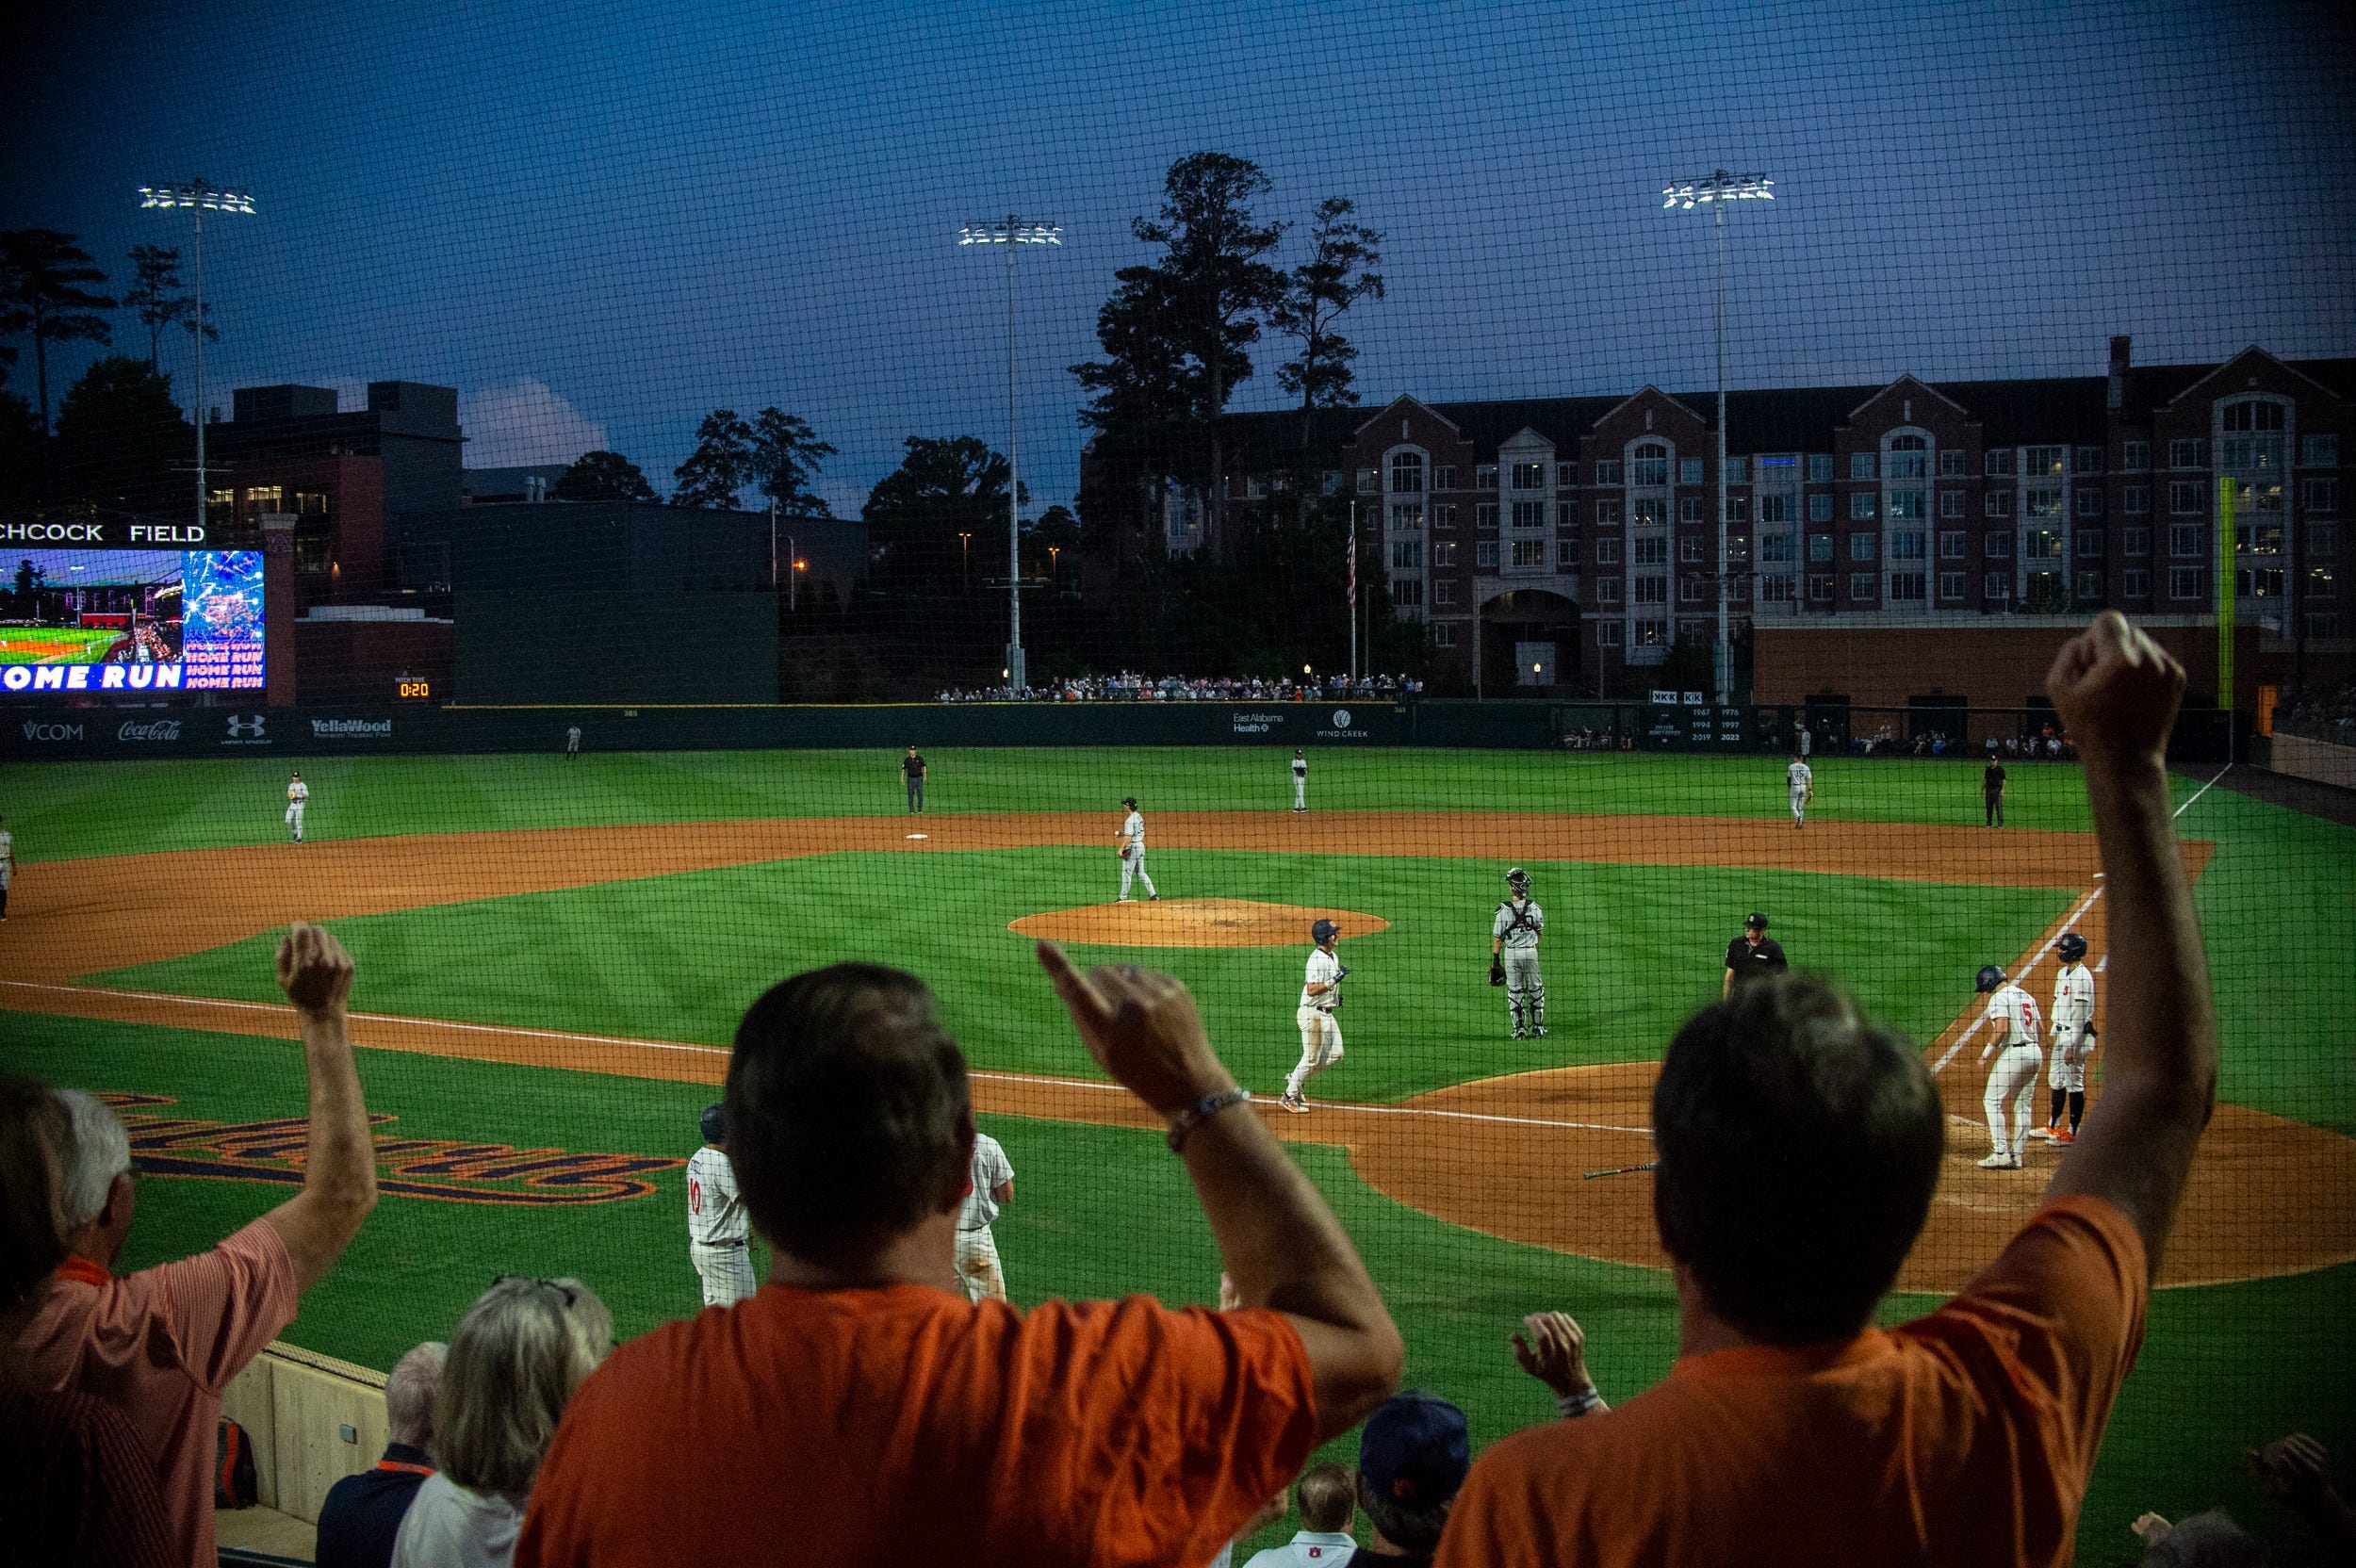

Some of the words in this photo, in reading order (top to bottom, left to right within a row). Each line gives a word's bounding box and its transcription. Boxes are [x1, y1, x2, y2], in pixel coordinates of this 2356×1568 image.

[0, 524, 104, 541] HCOCK
[130, 526, 205, 542] FIELD
[186, 652, 229, 662] HOME
[230, 652, 263, 662] RUN
[186, 664, 230, 676] HOME
[231, 664, 263, 676] RUN
[0, 665, 90, 690] OME
[102, 665, 181, 688] RUN
[186, 678, 231, 688] HOME
[231, 678, 263, 688] RUN
[401, 683, 429, 696] 0:20
[1234, 713, 1251, 722] East
[1251, 713, 1284, 722] Alabama
[24, 721, 83, 740] VCOM
[311, 719, 392, 732] YellaWood
[1234, 724, 1260, 732] Health
[2021, 1003, 2033, 1026] 5
[690, 1178, 701, 1216] 10
